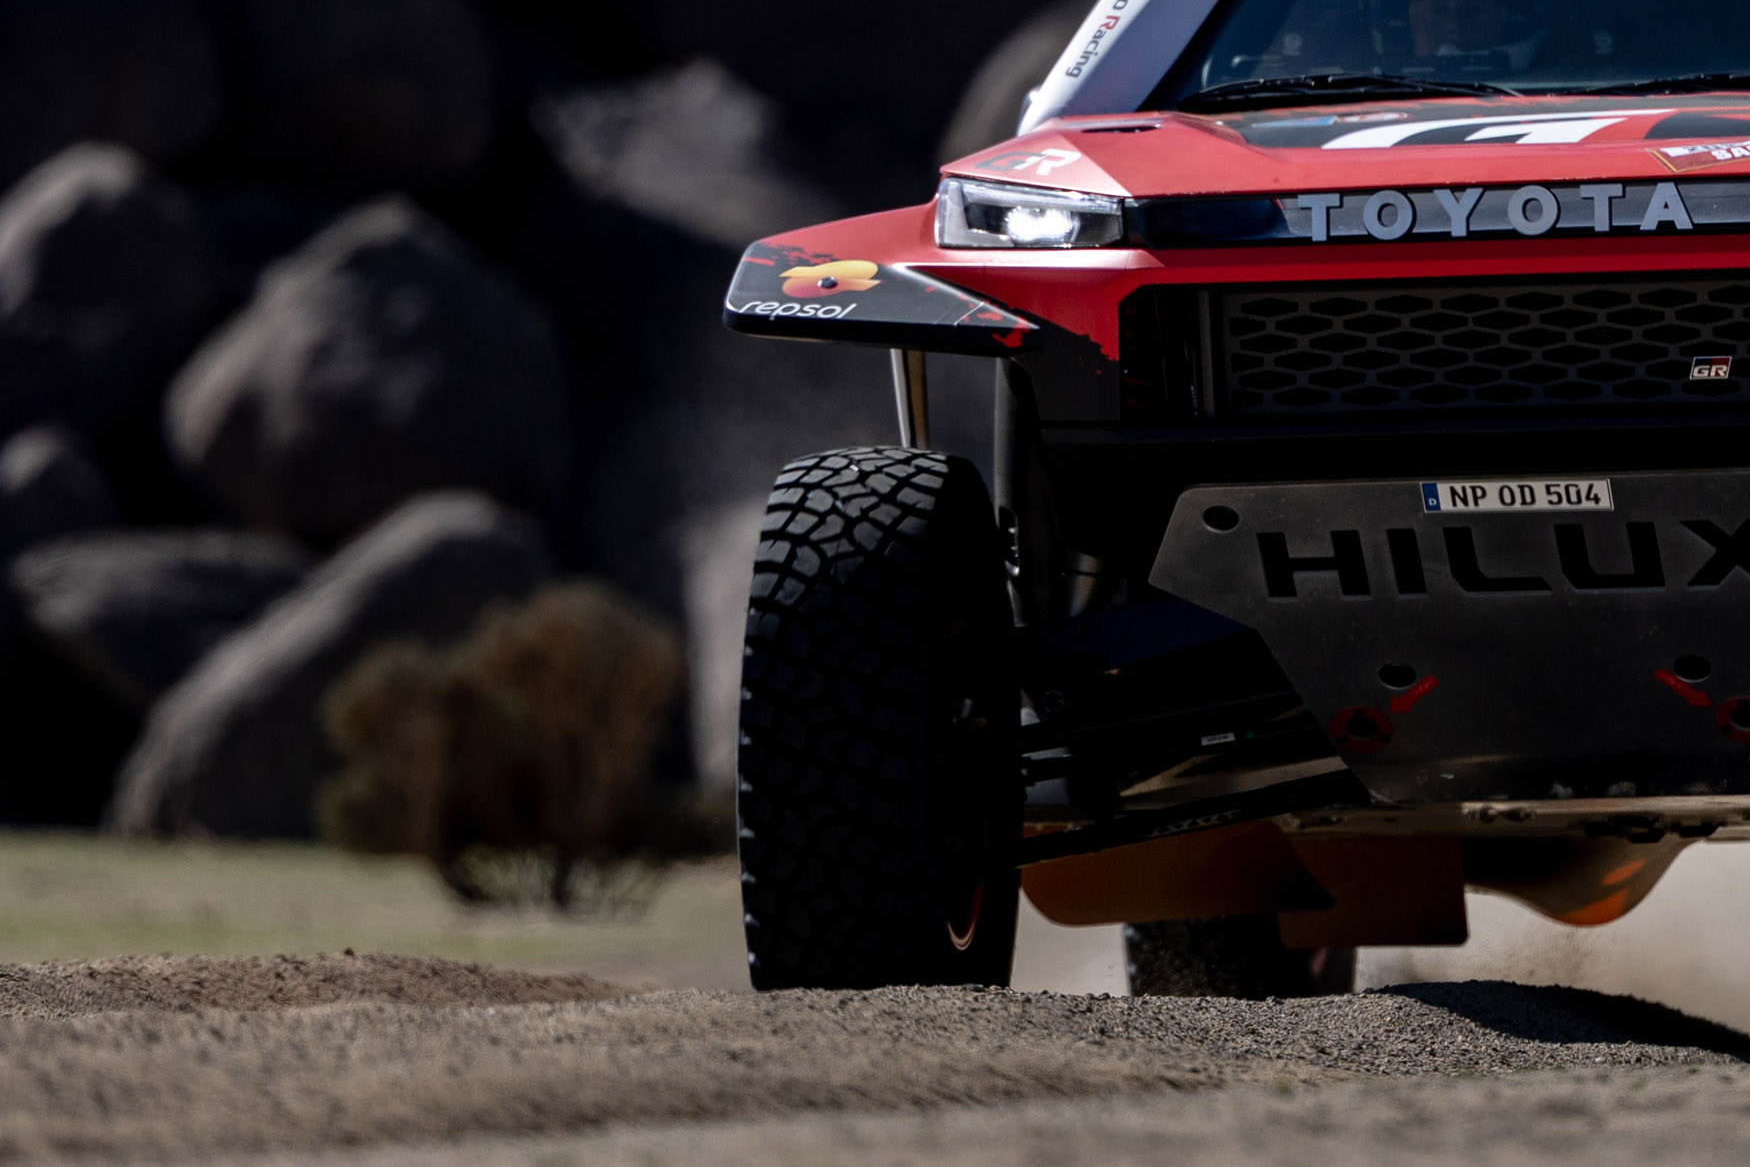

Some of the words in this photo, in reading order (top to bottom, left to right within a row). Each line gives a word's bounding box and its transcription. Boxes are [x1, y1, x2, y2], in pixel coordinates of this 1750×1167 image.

[1065, 15, 1121, 78] Racing
[975, 148, 1082, 176] GR
[1297, 181, 1694, 242] TOYOTA
[738, 301, 858, 321] repsol
[1692, 364, 1728, 377] GR
[1450, 485, 1487, 507] NP
[1499, 484, 1537, 506] OD
[1545, 483, 1602, 506] 504
